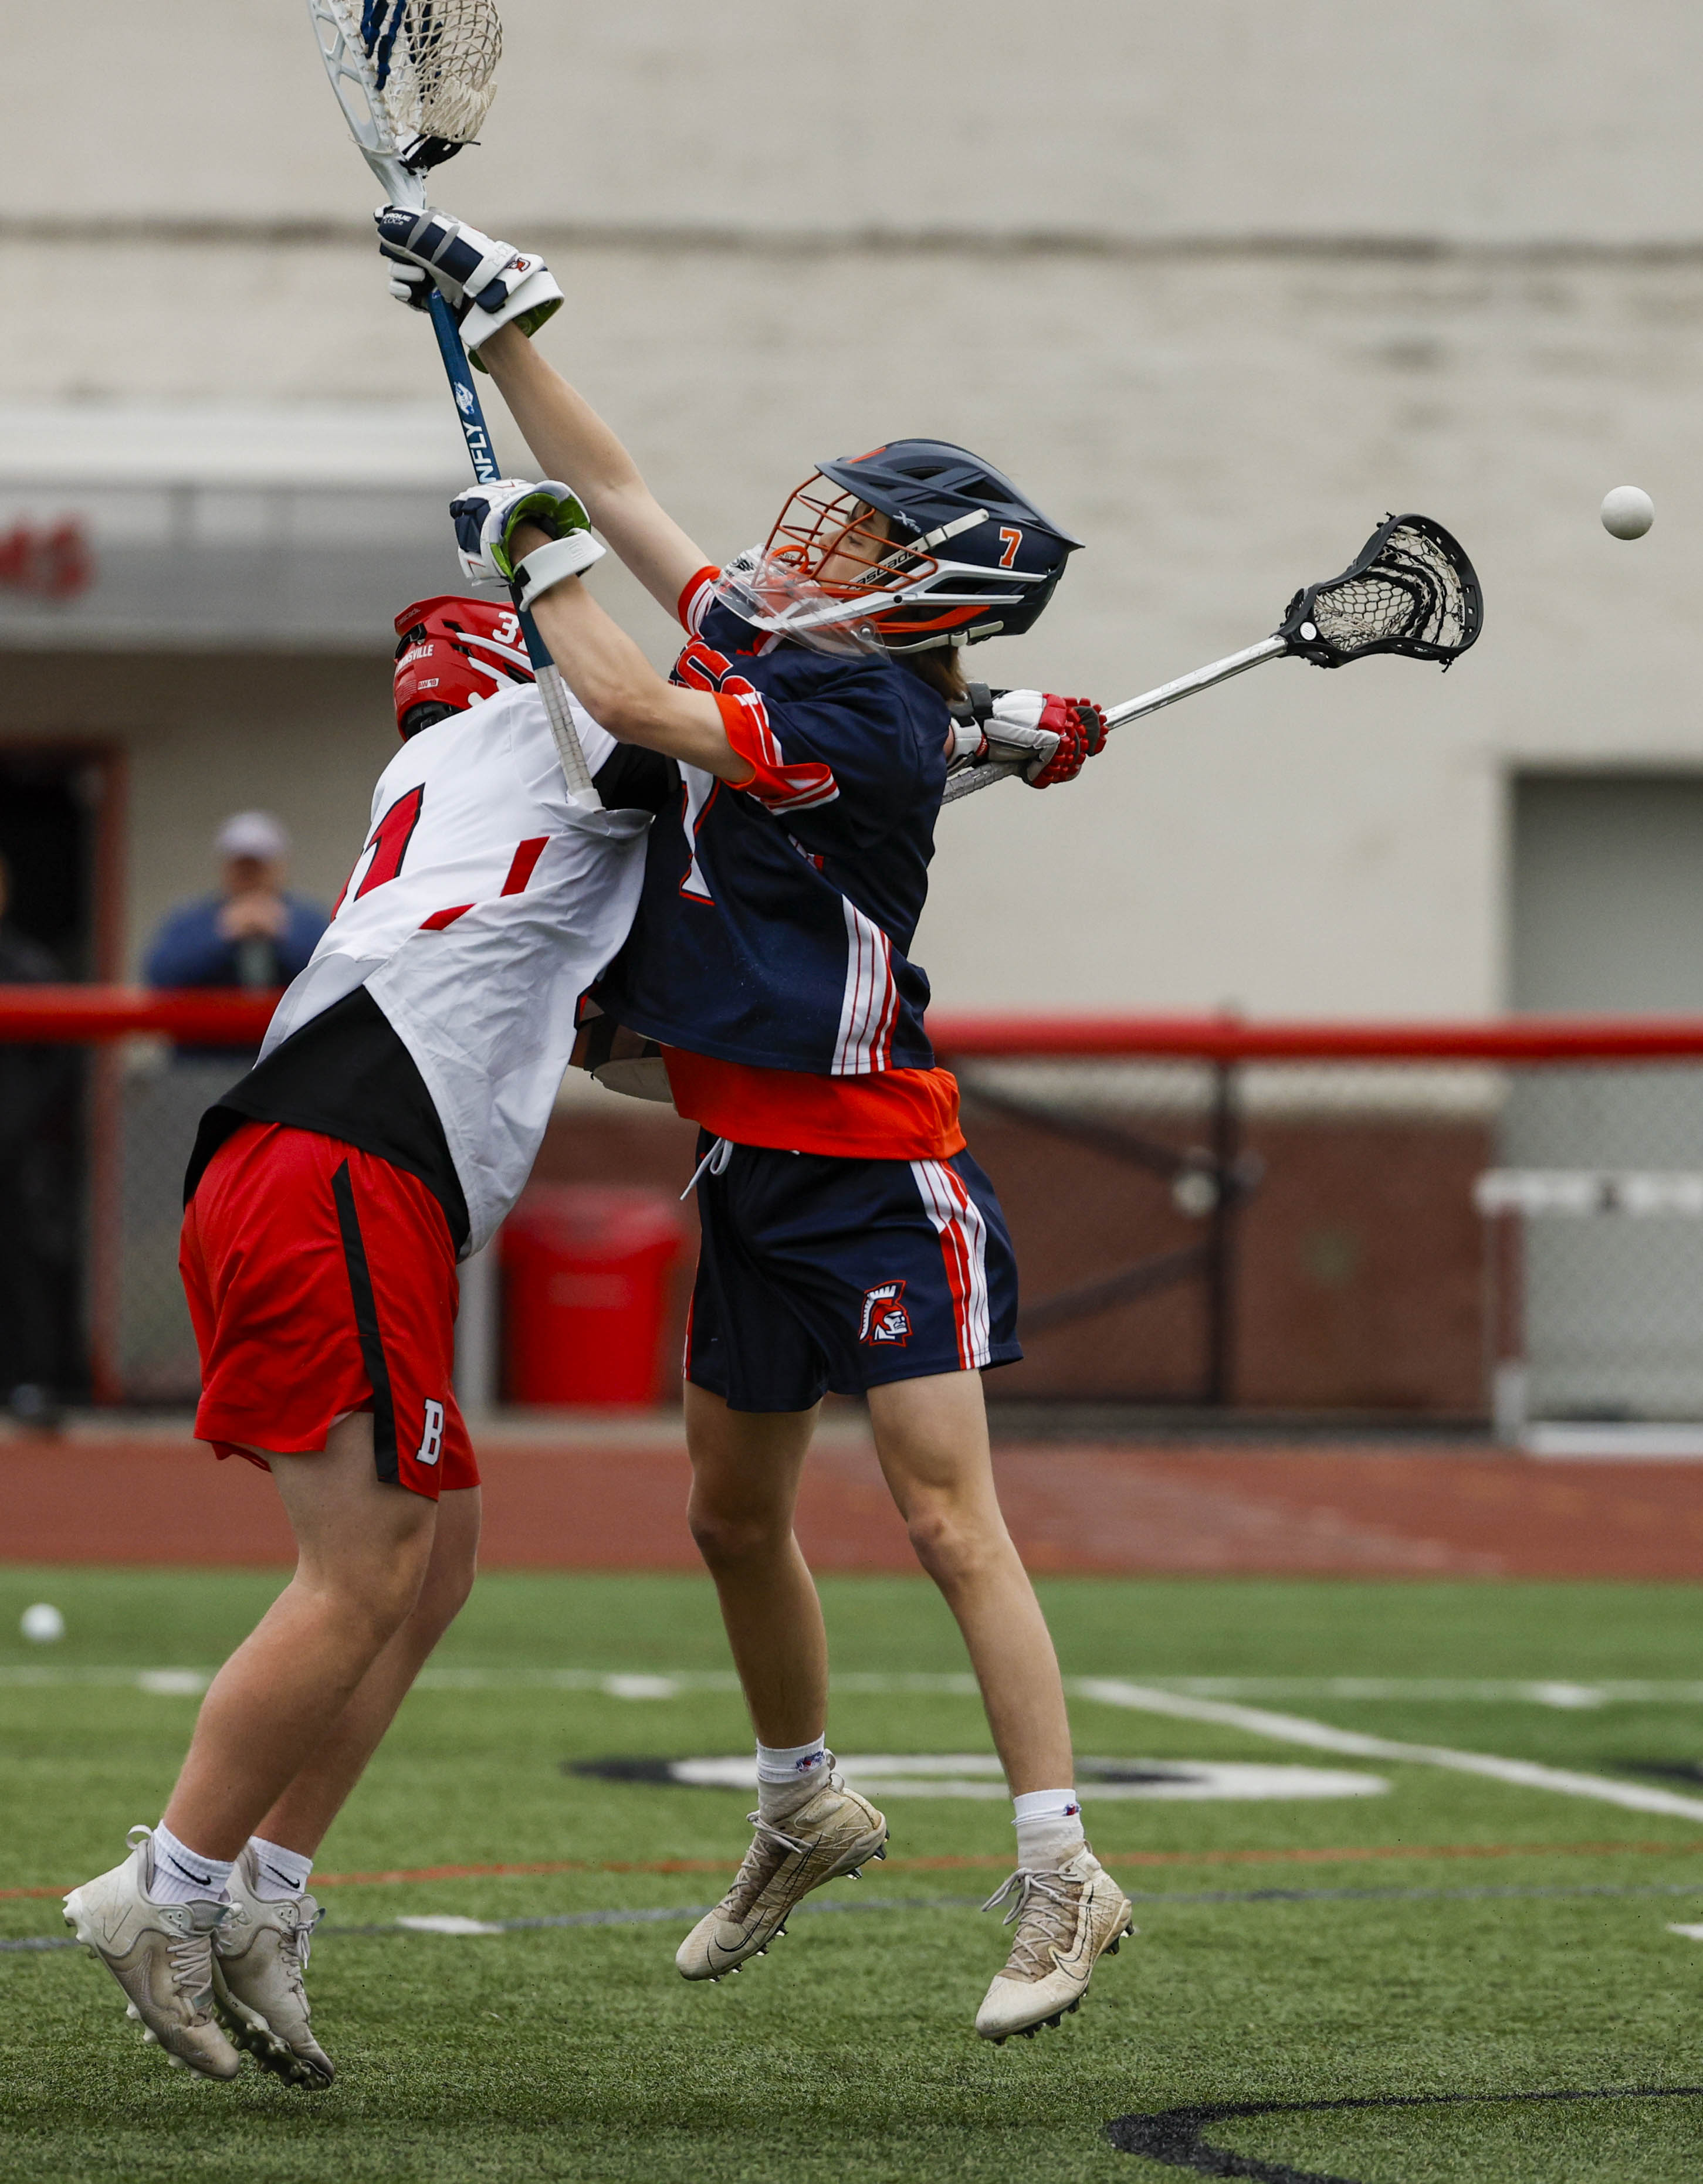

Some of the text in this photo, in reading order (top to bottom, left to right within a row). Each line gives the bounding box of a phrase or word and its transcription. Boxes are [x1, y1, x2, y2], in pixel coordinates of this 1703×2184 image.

[848, 545, 919, 590] ascade
[999, 526, 1023, 569] 7
[415, 1397, 444, 1466] B
